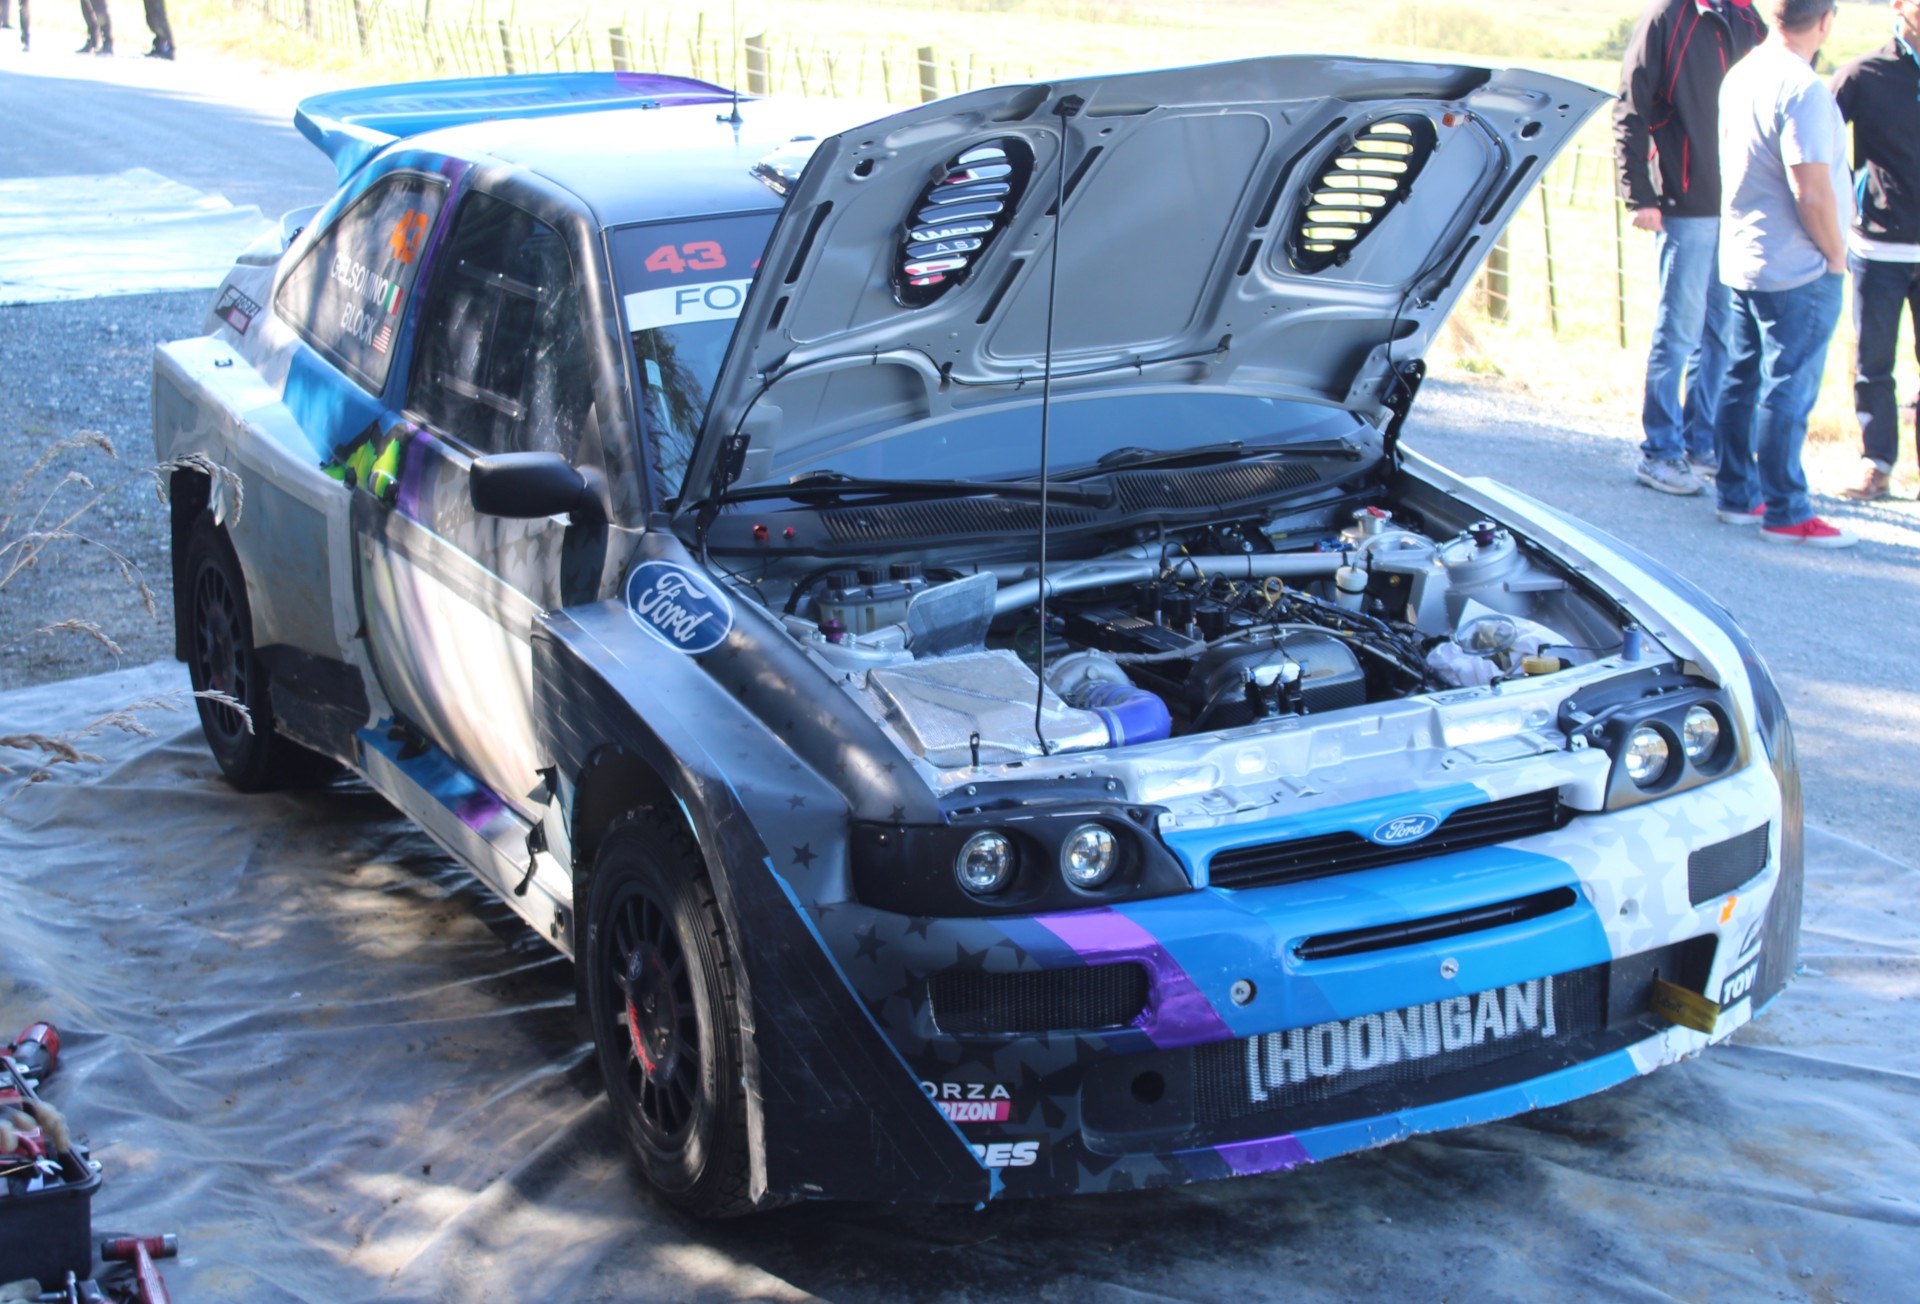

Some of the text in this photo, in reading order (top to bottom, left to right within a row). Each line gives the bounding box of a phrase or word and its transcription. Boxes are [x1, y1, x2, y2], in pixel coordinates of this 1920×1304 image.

[389, 208, 428, 265] 43
[644, 240, 727, 274] 43
[675, 283, 751, 315] FO
[341, 301, 377, 346] BLOCK
[638, 571, 714, 642] Ford
[1385, 818, 1426, 839] Ford
